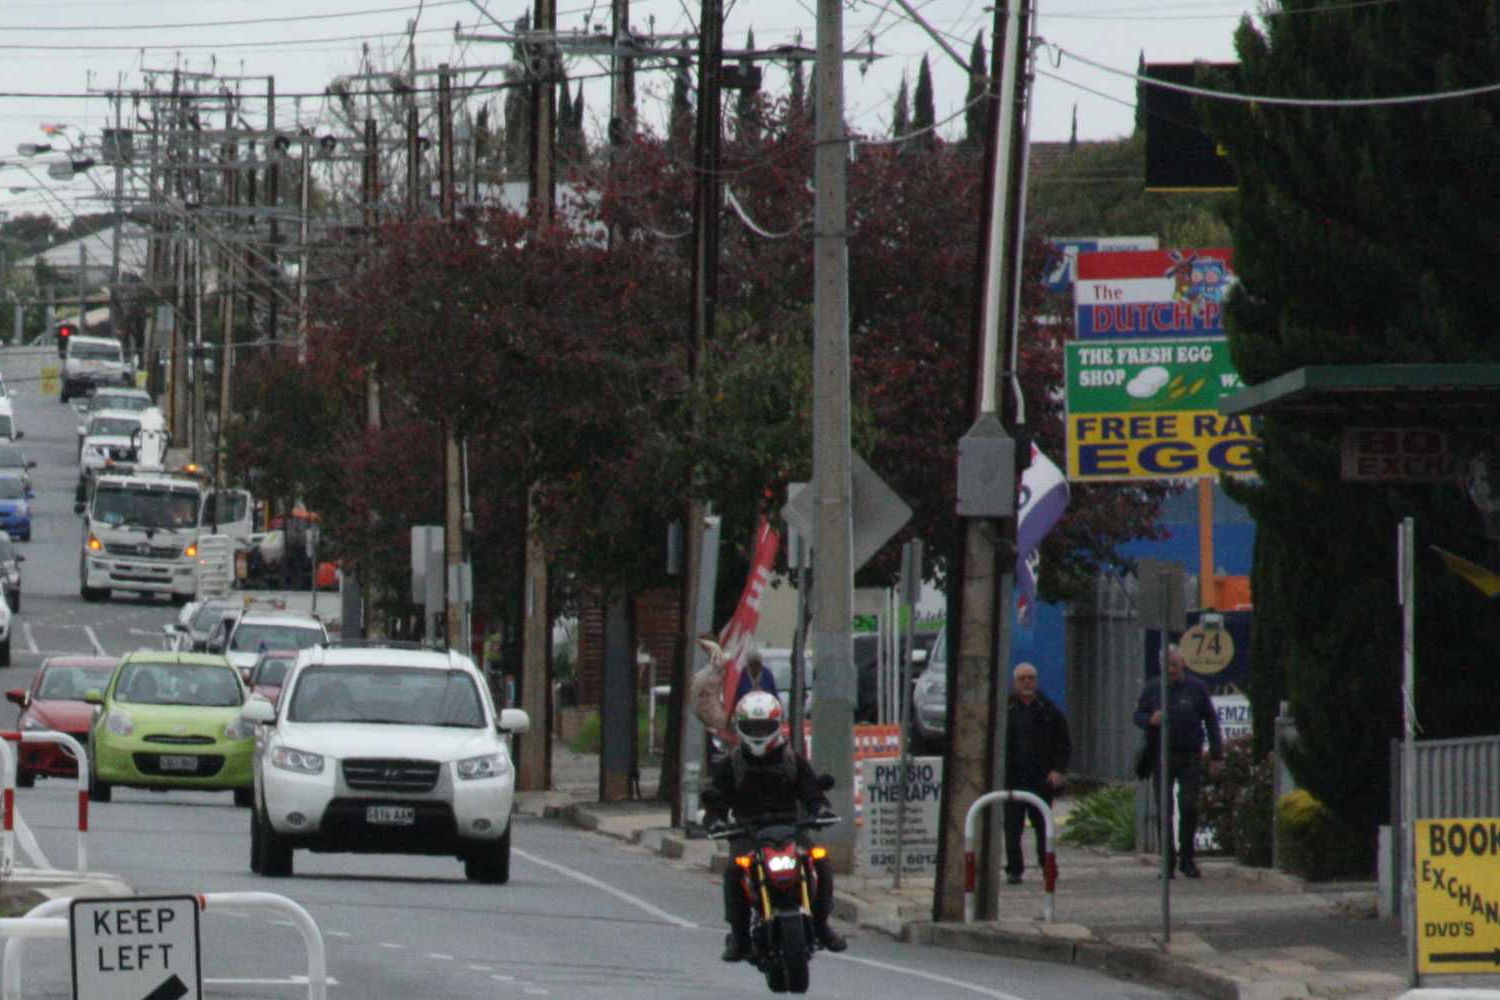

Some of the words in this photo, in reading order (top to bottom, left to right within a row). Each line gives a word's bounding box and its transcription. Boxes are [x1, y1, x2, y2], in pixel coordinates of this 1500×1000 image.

[1092, 285, 1124, 300] The
[1092, 303, 1193, 332] DUTCH
[1078, 349, 1113, 365] THE
[1117, 347, 1173, 364] FRESH
[1177, 346, 1213, 363] EGG
[1079, 369, 1126, 387] SHOP
[1076, 416, 1178, 440] FREE
[1194, 415, 1257, 436] RA
[1078, 440, 1264, 475] EGG
[1191, 633, 1221, 656] 74
[875, 764, 933, 783] PHSIO
[1422, 860, 1500, 924] EXCHAN
[94, 908, 175, 935] KEEP
[1424, 922, 1475, 937] DVD'S
[99, 944, 173, 971] LEFT
